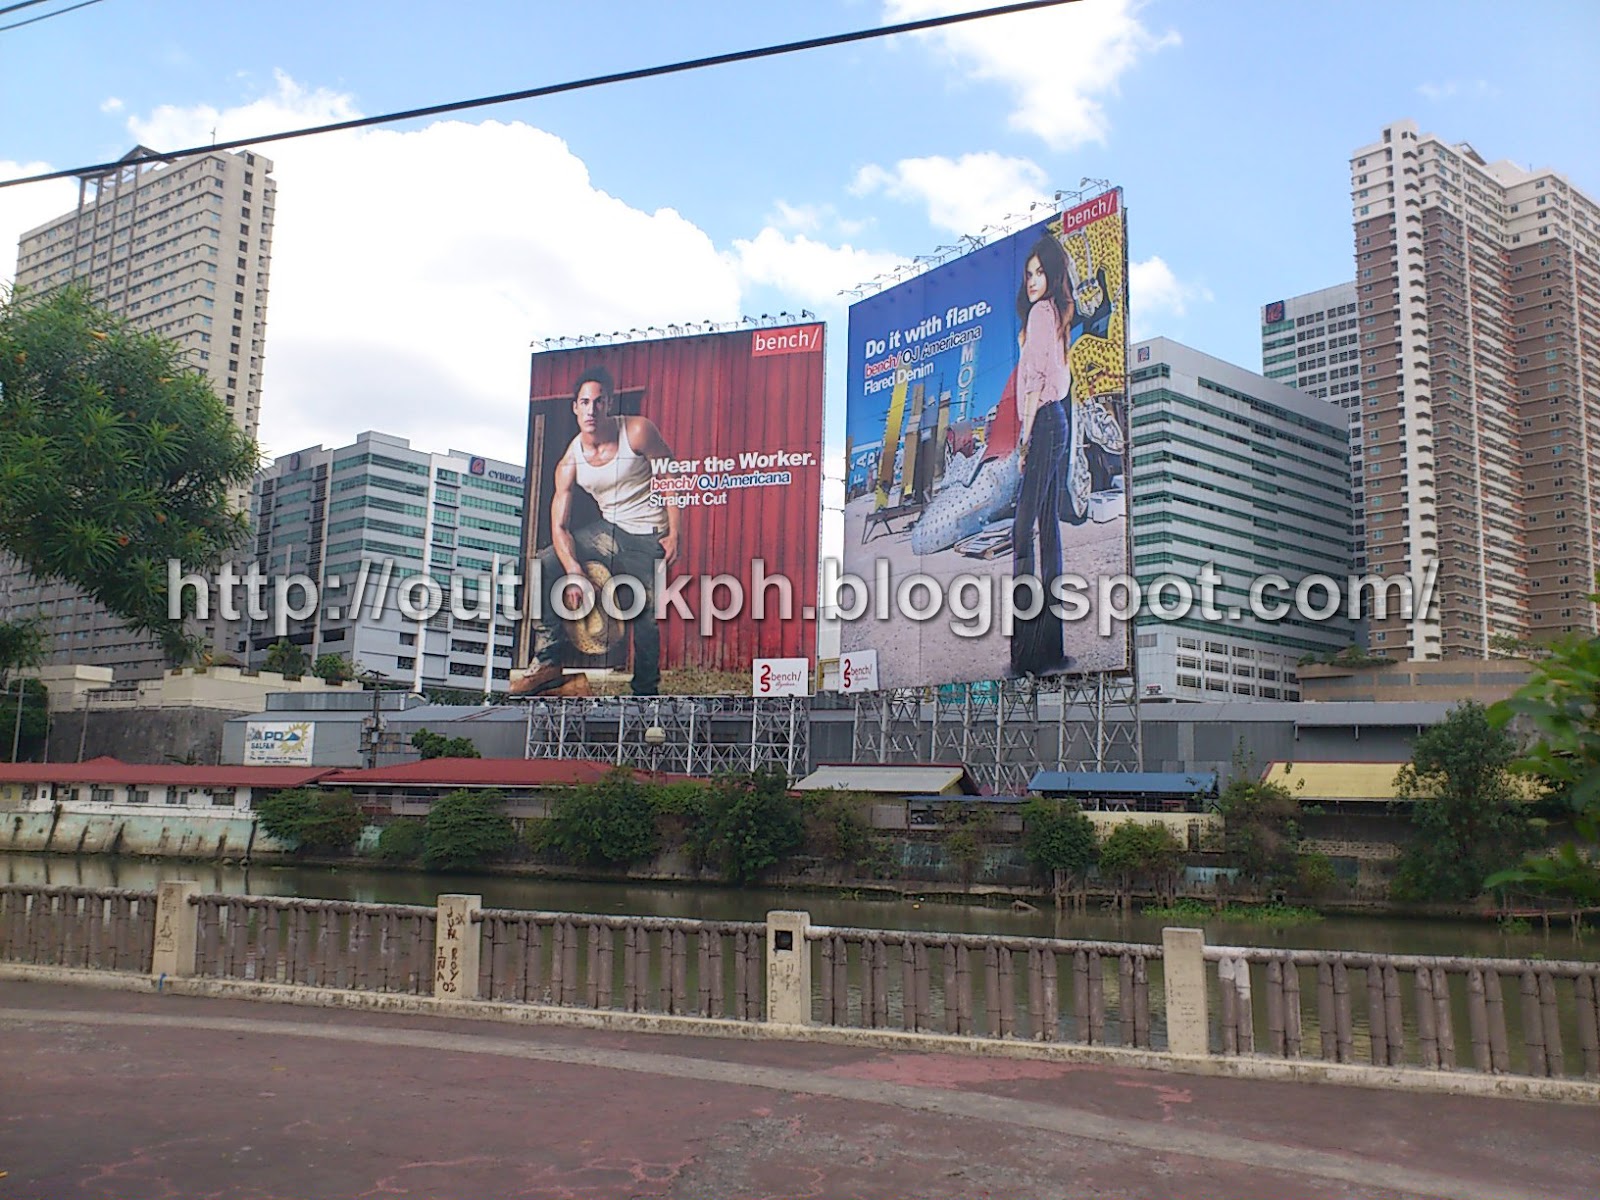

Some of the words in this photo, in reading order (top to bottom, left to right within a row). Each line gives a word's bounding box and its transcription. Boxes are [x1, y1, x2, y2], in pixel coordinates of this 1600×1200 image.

[1067, 193, 1114, 228] bench/
[755, 328, 820, 351] bench/
[865, 340, 886, 360] Do
[889, 330, 901, 350] it
[904, 315, 941, 343] with
[946, 301, 992, 328] flare.
[865, 352, 902, 378] bench/
[903, 347, 919, 364] OJ
[922, 327, 982, 359] Americana
[864, 373, 895, 396] Flared
[897, 362, 934, 384] Denim
[651, 458, 700, 475] Wear
[704, 456, 735, 472] the
[739, 450, 817, 469] Worker.
[652, 476, 698, 492] bench/
[699, 475, 718, 490] OJ
[720, 471, 791, 488] Americana
[650, 492, 700, 508] Straight
[702, 491, 727, 506] Cut
[771, 671, 802, 682] bench/
